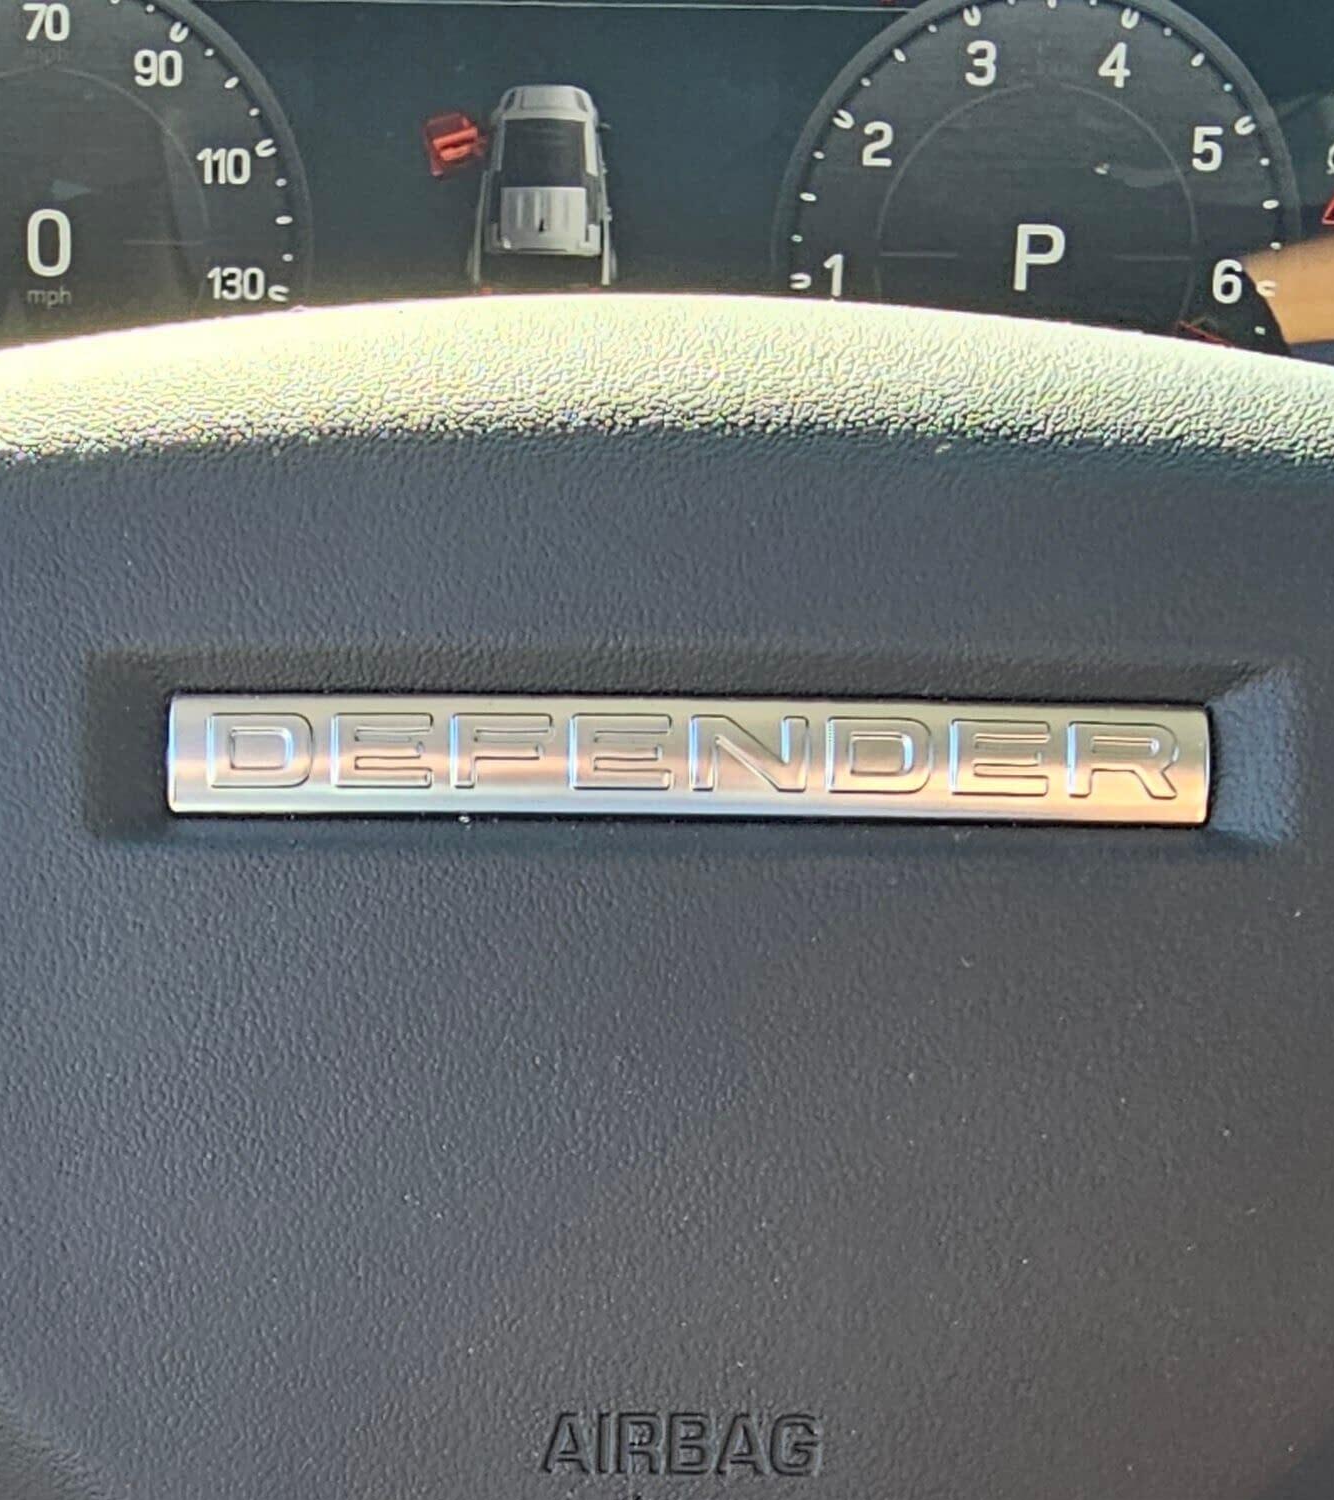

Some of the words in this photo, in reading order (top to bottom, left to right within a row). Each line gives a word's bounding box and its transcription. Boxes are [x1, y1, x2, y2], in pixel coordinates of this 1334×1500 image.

[24, 2, 70, 42] 70
[133, 49, 183, 88] 90
[964, 39, 997, 87] 3
[1097, 41, 1131, 89] 4
[196, 147, 252, 186] 110
[861, 120, 893, 168] 2
[1191, 125, 1224, 171] 5
[26, 208, 72, 277] 0
[1013, 223, 1067, 292] P
[27, 283, 72, 307] mph
[206, 266, 265, 301] 130
[822, 253, 844, 298] 1
[1211, 259, 1243, 304] 6
[203, 710, 1179, 801] DEFENDER
[540, 1411, 823, 1477] AIRBAG
